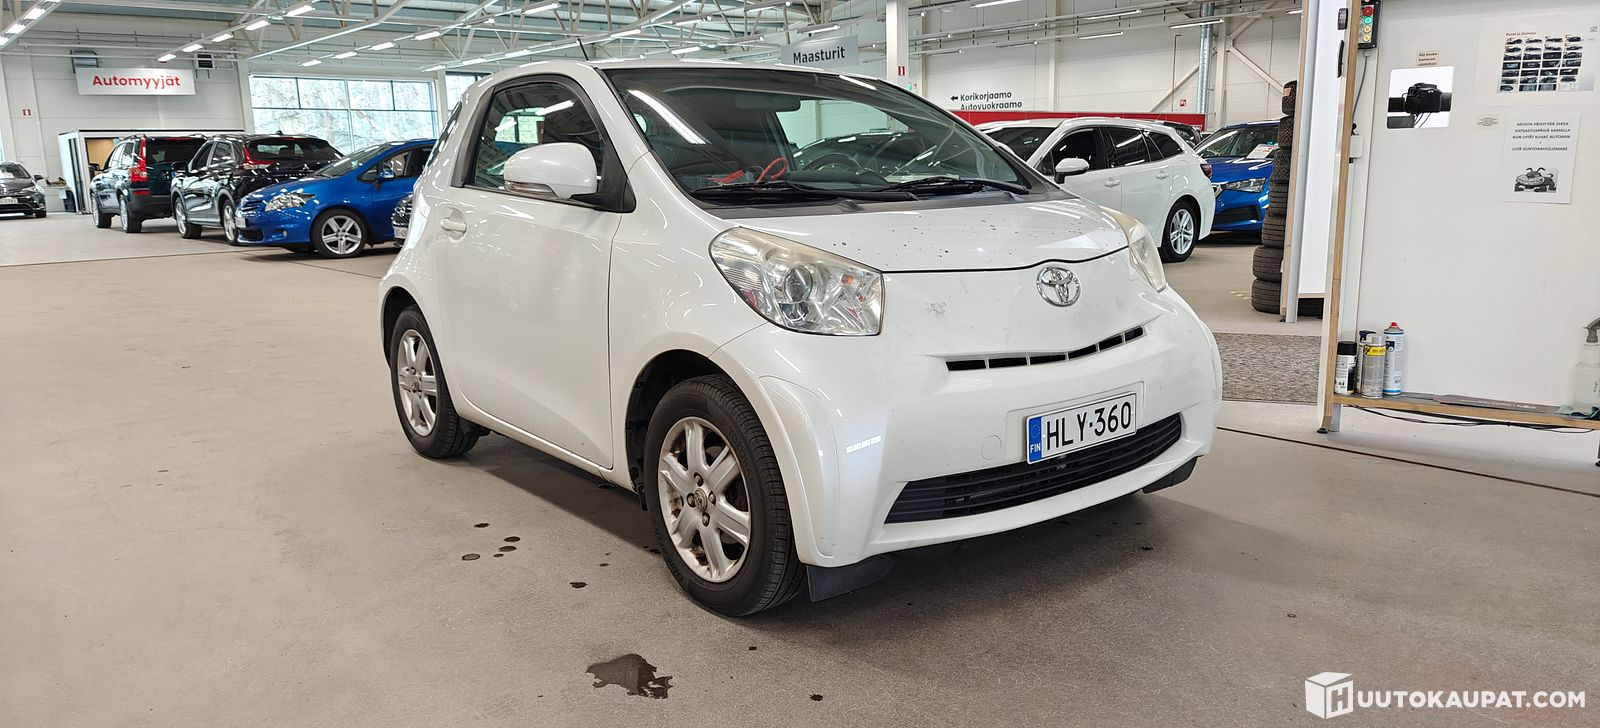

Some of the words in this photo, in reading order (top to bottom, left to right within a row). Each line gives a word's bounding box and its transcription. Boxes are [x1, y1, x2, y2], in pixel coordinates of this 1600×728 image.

[793, 46, 845, 64] Maasturit
[92, 75, 181, 90] Automyyjät
[960, 92, 1012, 102] Korikorjaamo
[960, 101, 1022, 110] Autovuokraamo
[1030, 443, 1040, 454] FIN
